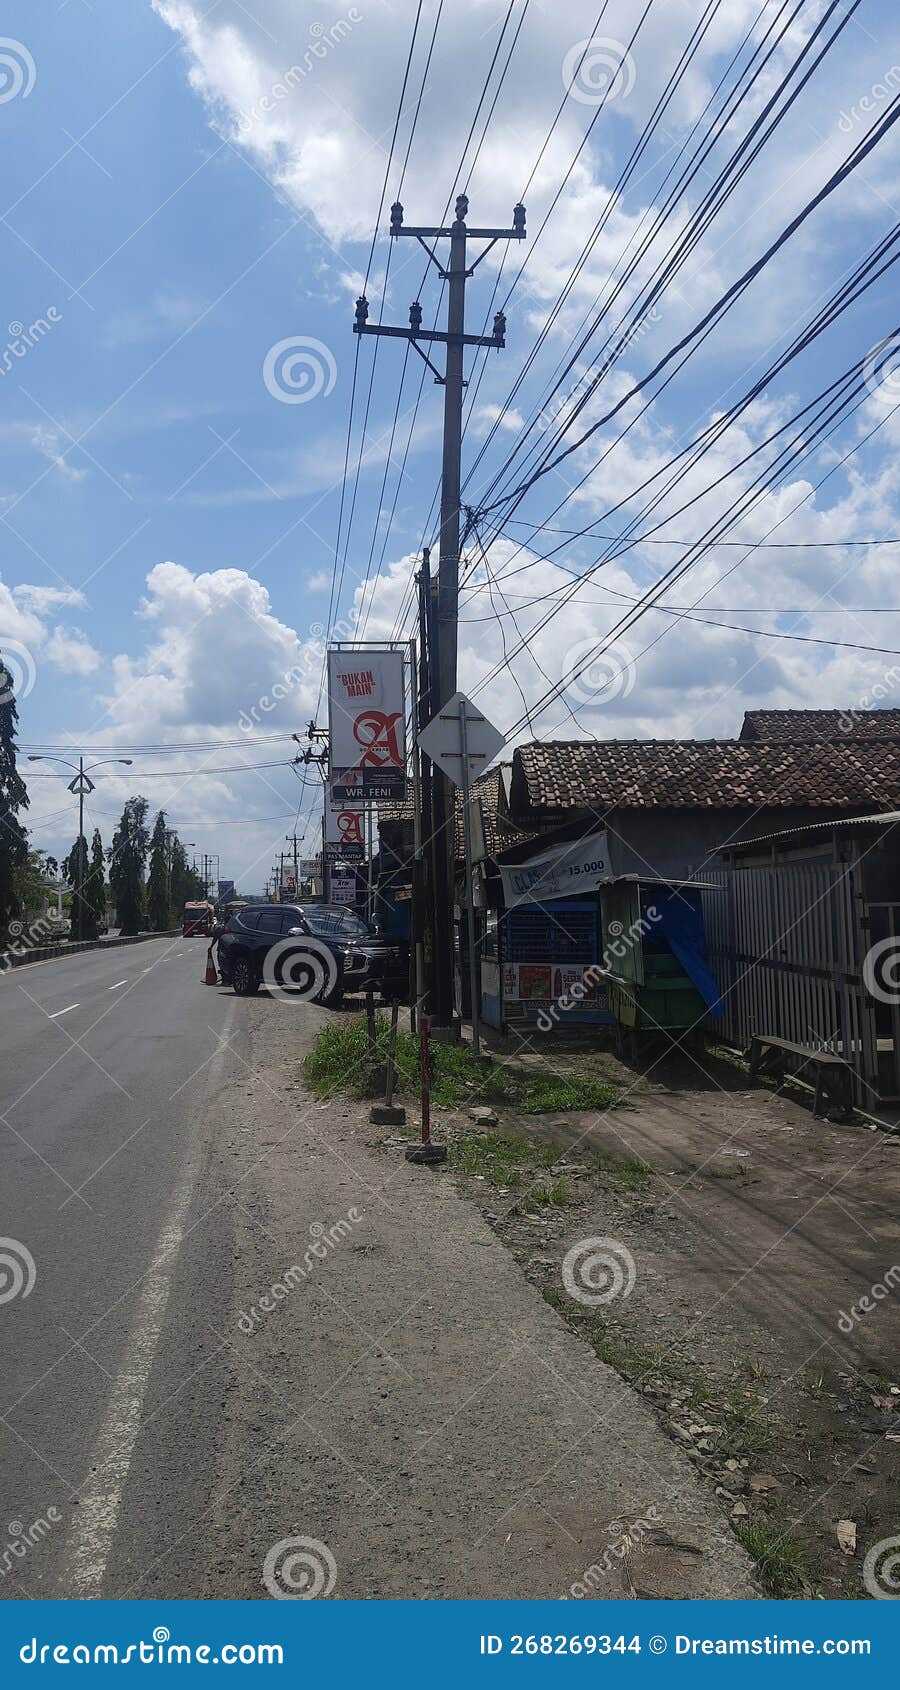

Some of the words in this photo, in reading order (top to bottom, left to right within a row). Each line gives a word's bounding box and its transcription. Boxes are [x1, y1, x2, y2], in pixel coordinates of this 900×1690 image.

[345, 788, 367, 797] WR.
[369, 788, 392, 797] FENI
[568, 860, 605, 876] 15.000
